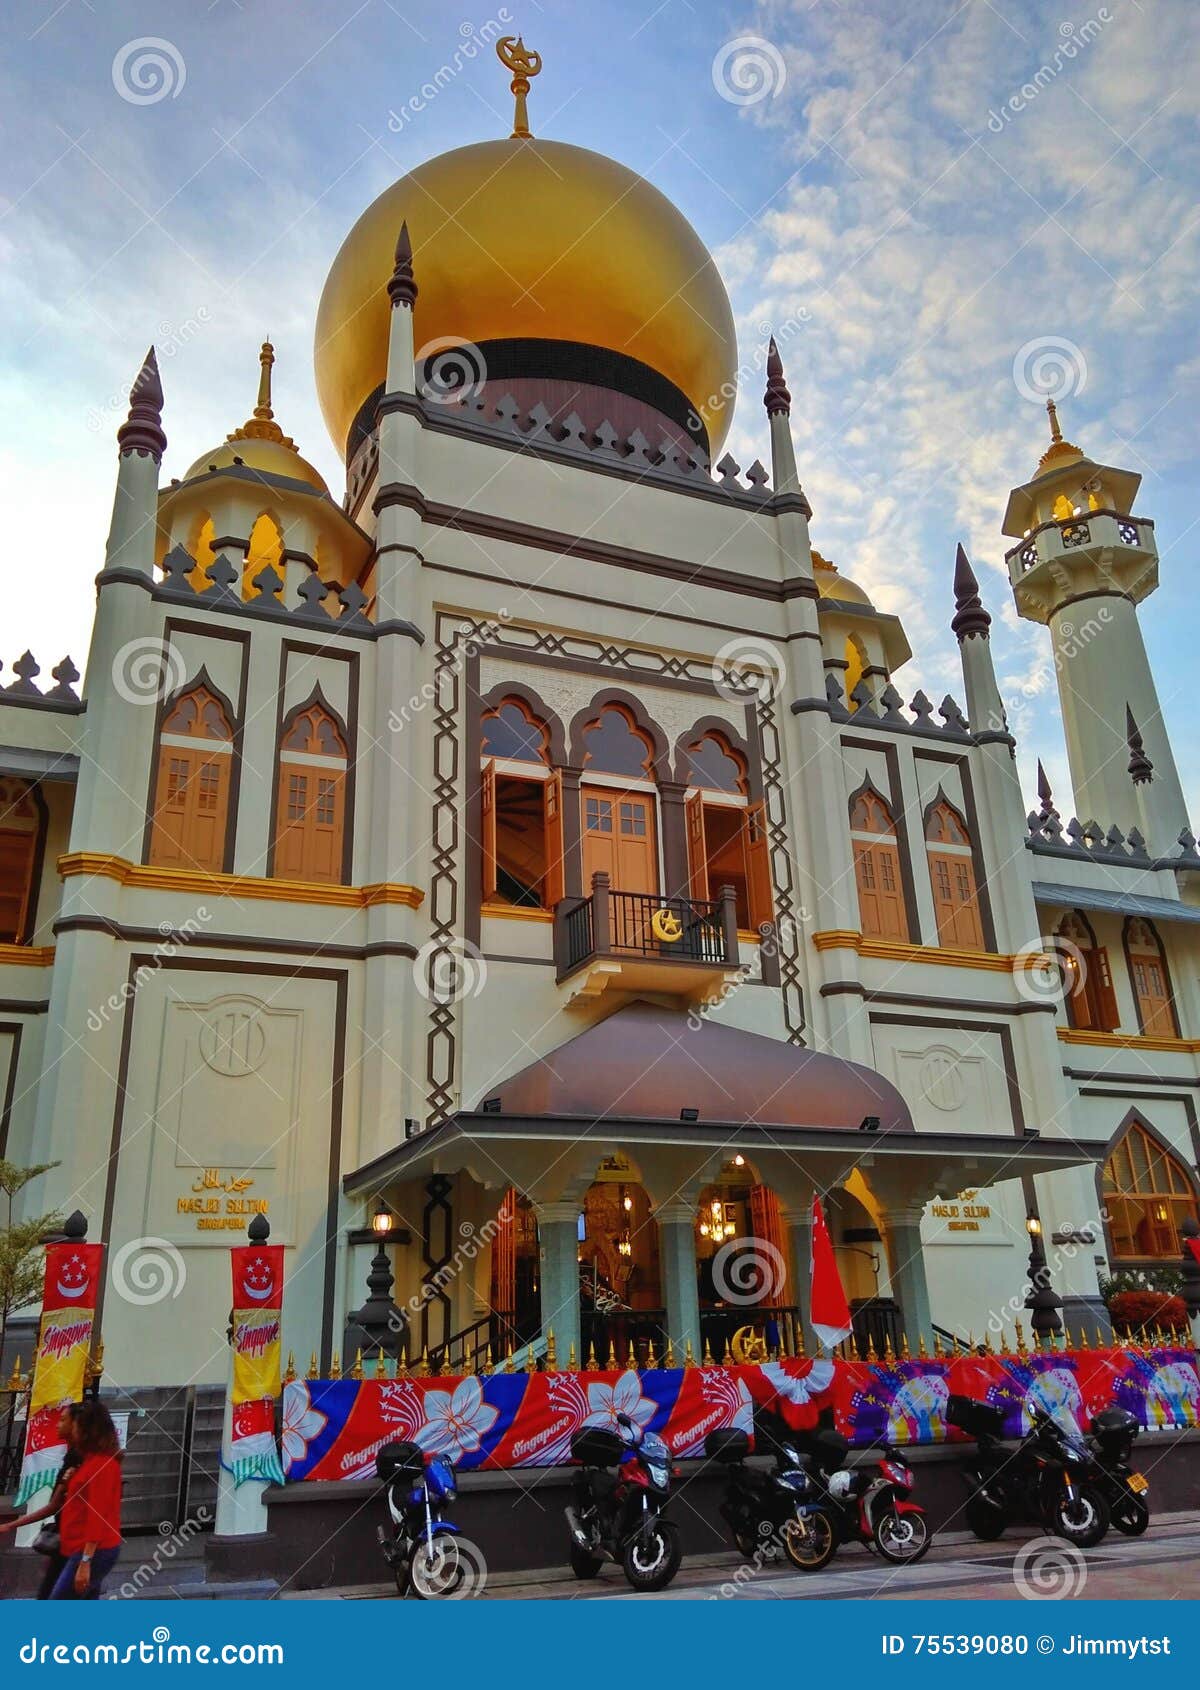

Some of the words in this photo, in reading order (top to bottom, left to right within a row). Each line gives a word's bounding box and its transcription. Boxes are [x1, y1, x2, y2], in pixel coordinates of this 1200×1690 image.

[226, 1199, 269, 1214] SULTAN
[963, 1205, 991, 1218] SULTAN
[339, 1424, 404, 1471] Singapore
[511, 1414, 570, 1459] Singapore
[671, 1405, 725, 1450] Singapore
